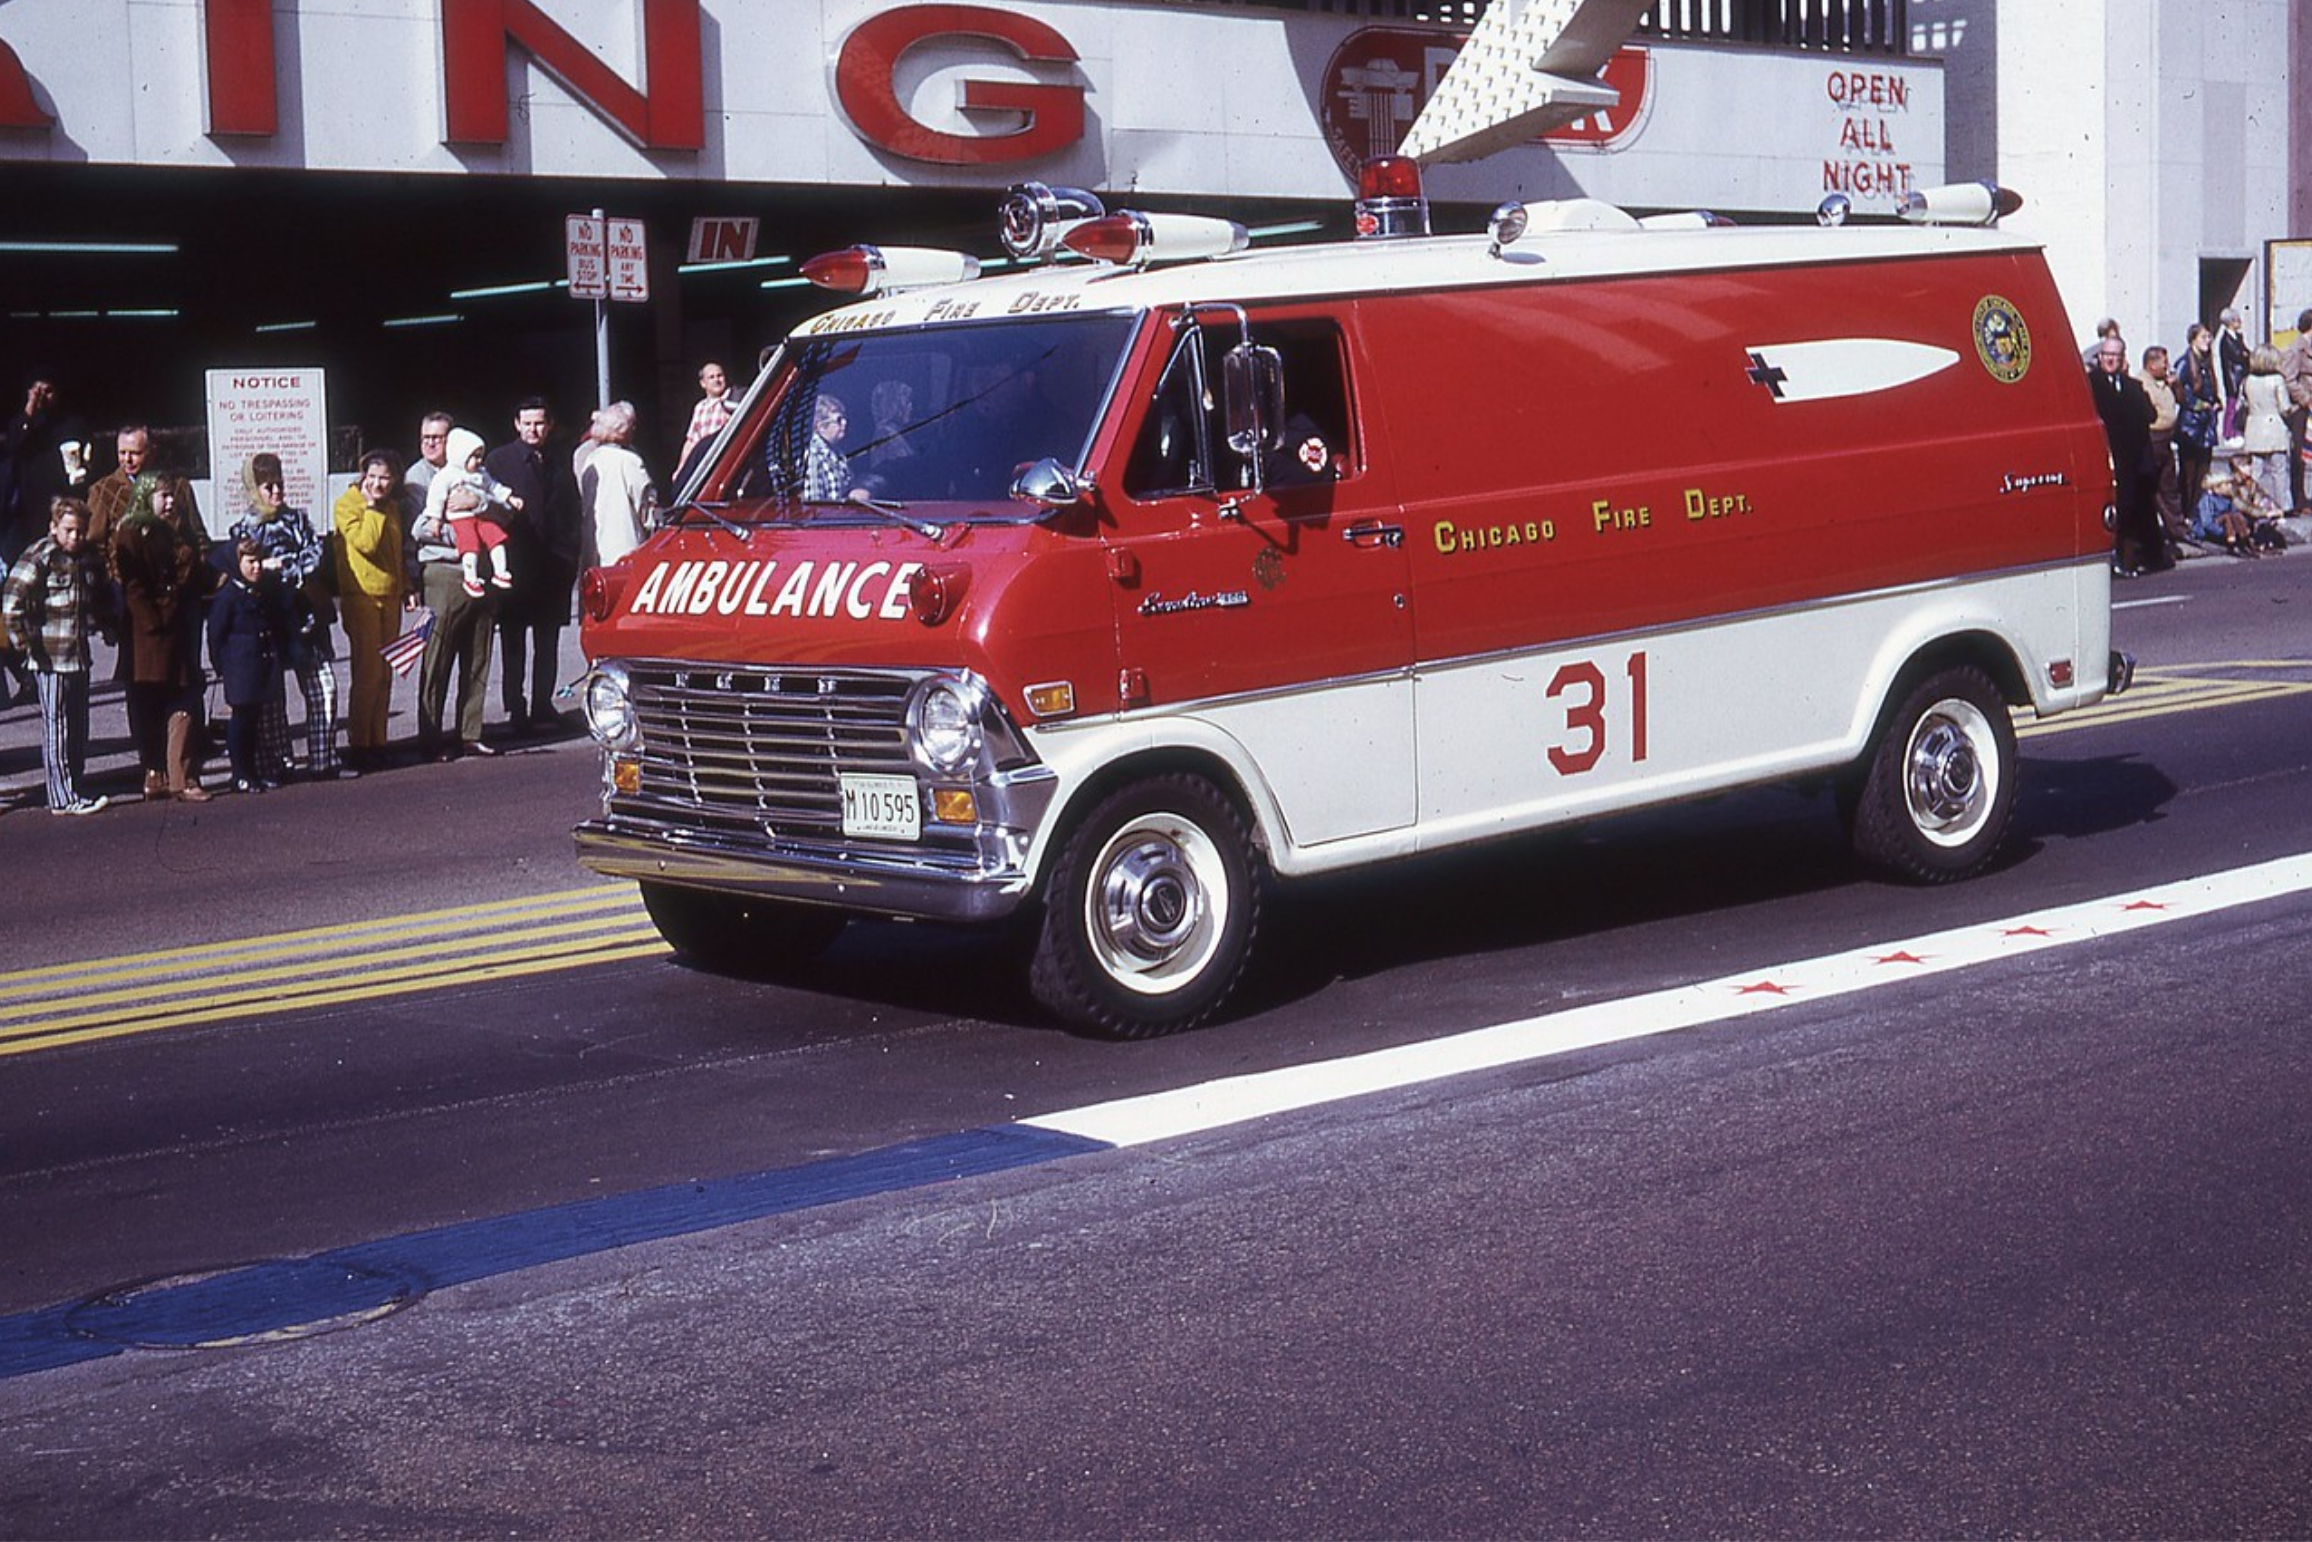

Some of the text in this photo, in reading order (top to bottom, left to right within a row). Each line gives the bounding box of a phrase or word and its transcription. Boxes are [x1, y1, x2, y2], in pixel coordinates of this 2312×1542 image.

[0, 0, 1084, 166] ING
[1827, 71, 1904, 106] OPEN
[1840, 117, 1892, 150] ALL
[1823, 160, 1910, 193] NIGHT
[577, 225, 593, 241] NO
[619, 228, 633, 243] NO
[699, 222, 750, 260] IN
[571, 242, 601, 257] PARKING
[610, 245, 642, 260] PARKING
[578, 259, 595, 270] BUS
[621, 263, 634, 271] ANY
[577, 271, 597, 282] STOP
[233, 377, 300, 388] NOTICE
[220, 399, 310, 410] NO TRESPASSING
[230, 411, 303, 422] OR LOITERING
[630, 561, 923, 619] AMBULANCE
[1546, 652, 1646, 776] 31
[862, 792, 880, 822] 10
[884, 793, 915, 824] 595
